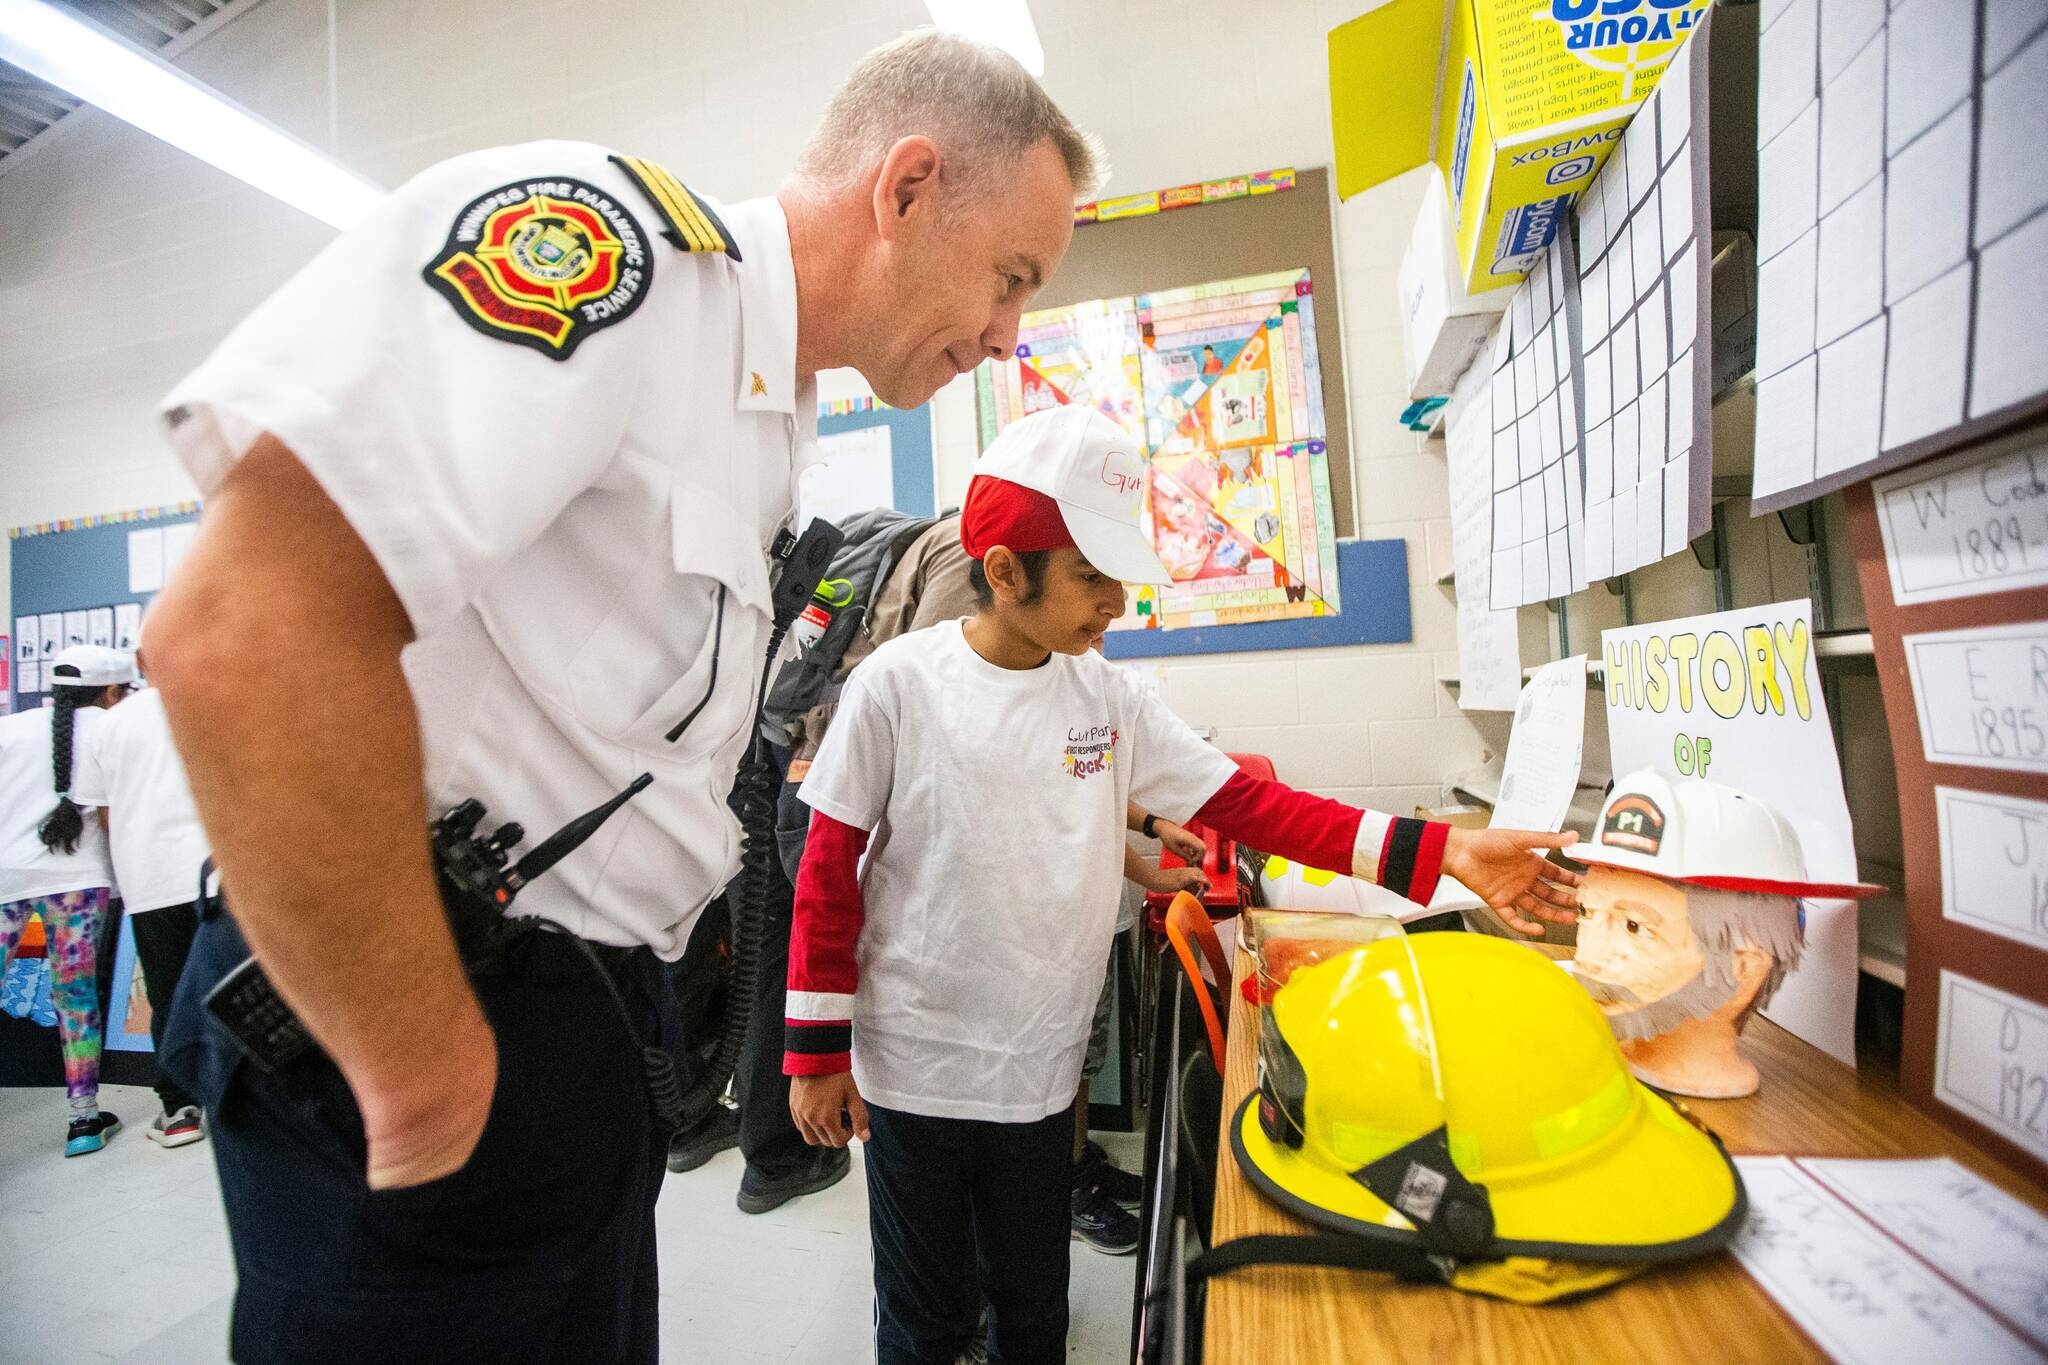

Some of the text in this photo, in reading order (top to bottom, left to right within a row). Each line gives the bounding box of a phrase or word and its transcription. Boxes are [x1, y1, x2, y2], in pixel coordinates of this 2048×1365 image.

[1499, 31, 1535, 49] jackets
[1567, 13, 1672, 49] YOUR
[1501, 40, 1561, 63] ns promo
[1502, 60, 1543, 78] printing
[1504, 75, 1538, 91] design
[1556, 74, 1587, 89] shirts
[1505, 87, 1544, 104] custom
[1544, 95, 1567, 107] logo
[1581, 97, 1608, 111] spirit
[1506, 106, 1534, 118] team
[1551, 107, 1577, 119] wear
[1507, 119, 1535, 131] swag
[1512, 127, 1626, 167] owBox
[527, 183, 573, 198] FIRE
[456, 188, 527, 242] WINNIPEG
[573, 188, 645, 267] PARAMEDIC
[582, 268, 643, 322] SERVICE
[1607, 618, 1812, 721] HISTORY
[1078, 742, 1111, 755] RESPONDERS
[1674, 733, 1712, 778] OF
[1073, 751, 1105, 779] ROCK
